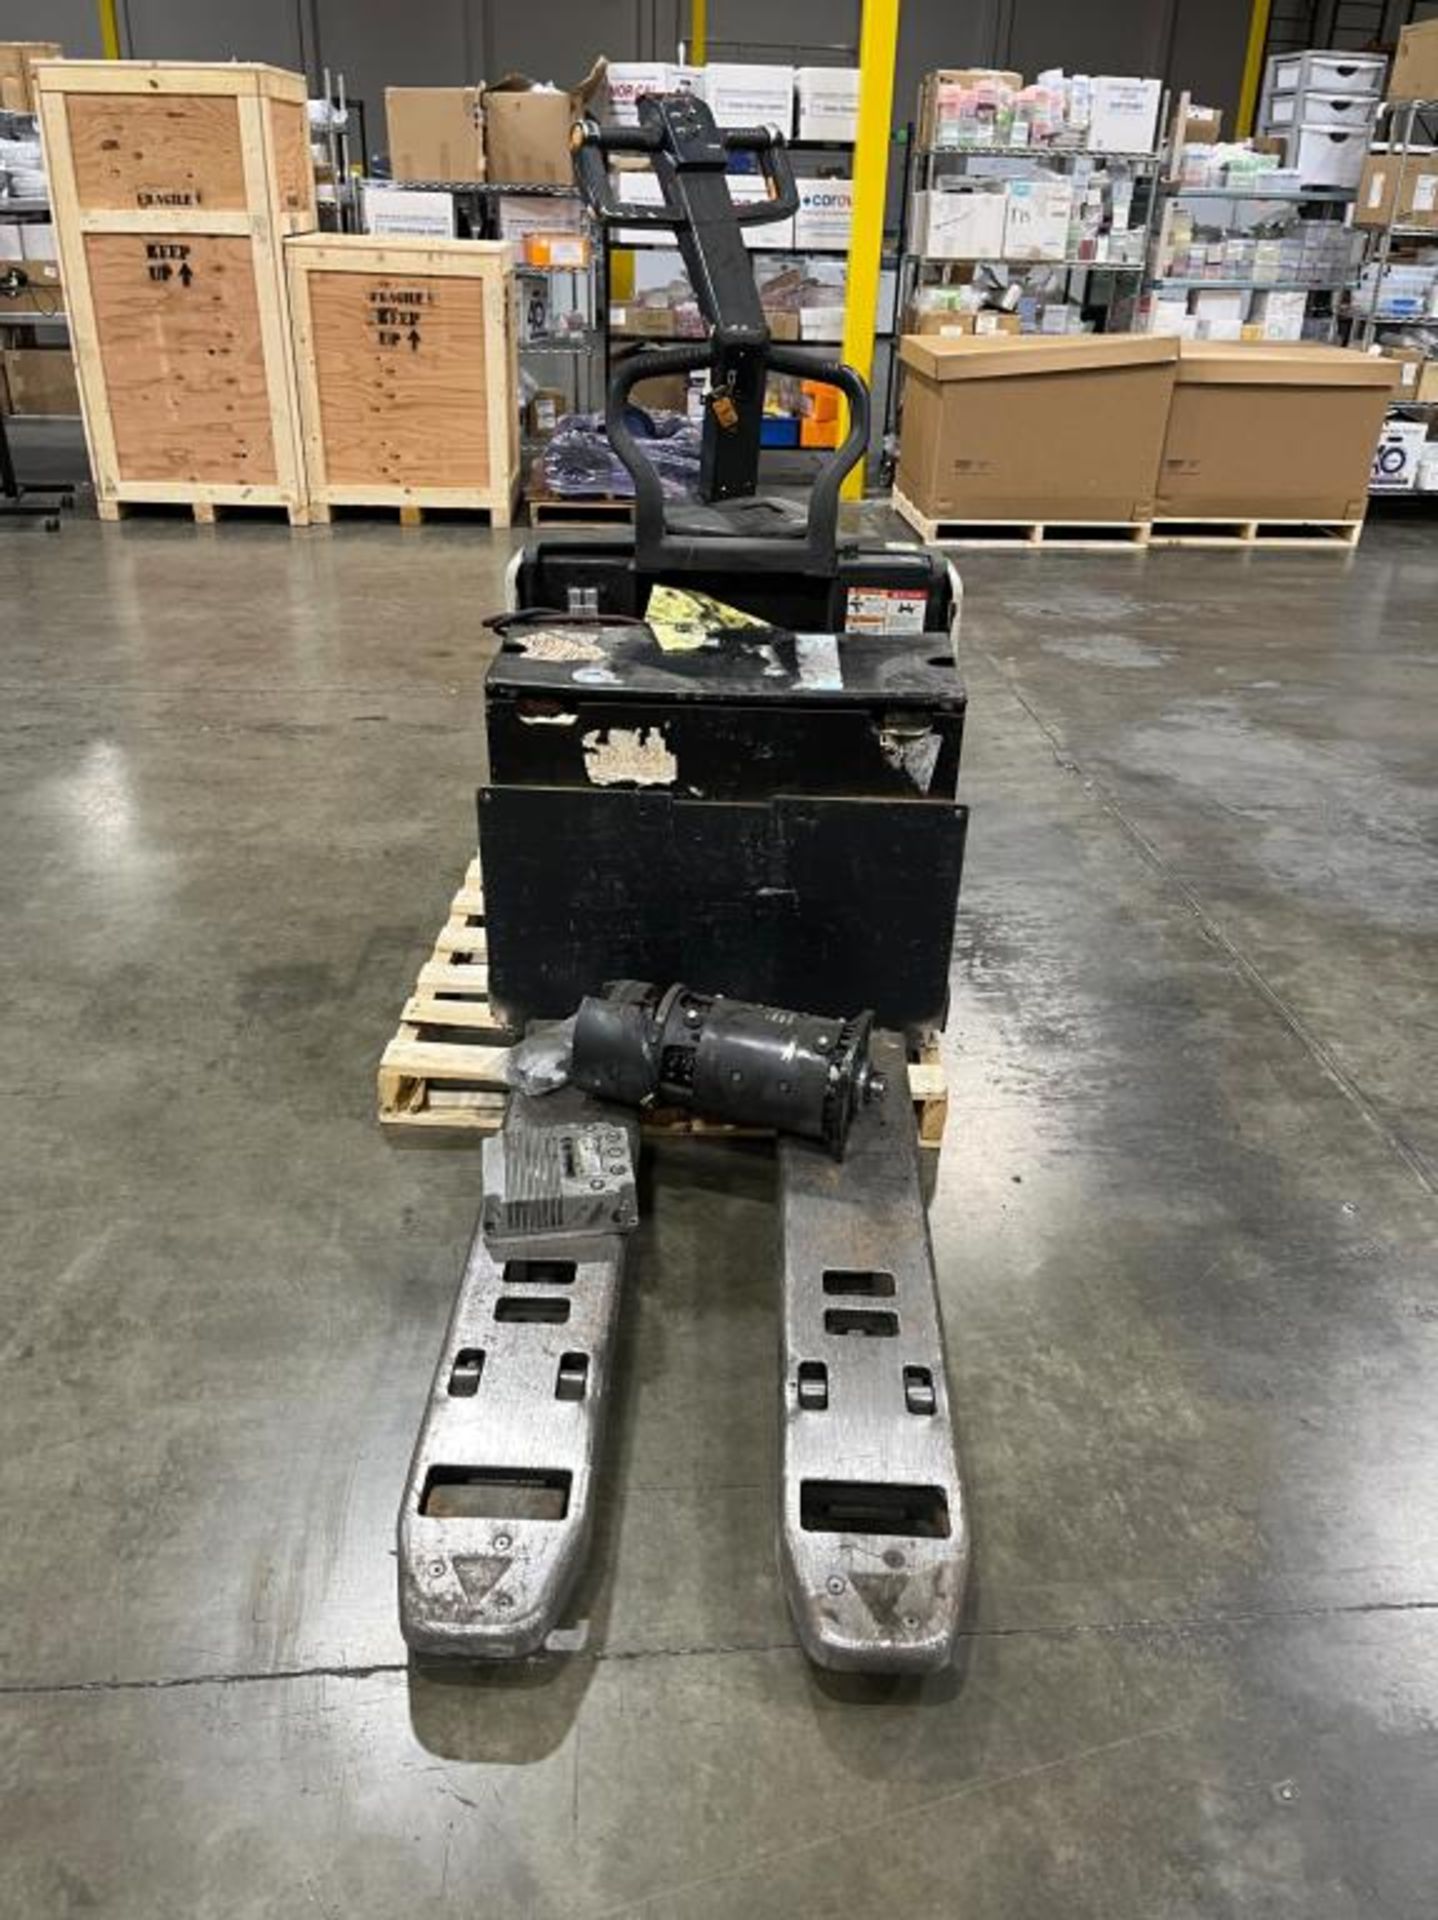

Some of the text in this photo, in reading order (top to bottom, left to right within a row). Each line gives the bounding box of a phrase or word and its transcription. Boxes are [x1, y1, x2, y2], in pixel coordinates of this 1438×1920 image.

[147, 244, 191, 260] KEEP
[149, 263, 173, 281] UP
[376, 308, 420, 326] KEEP
[379, 331, 401, 346] UP
